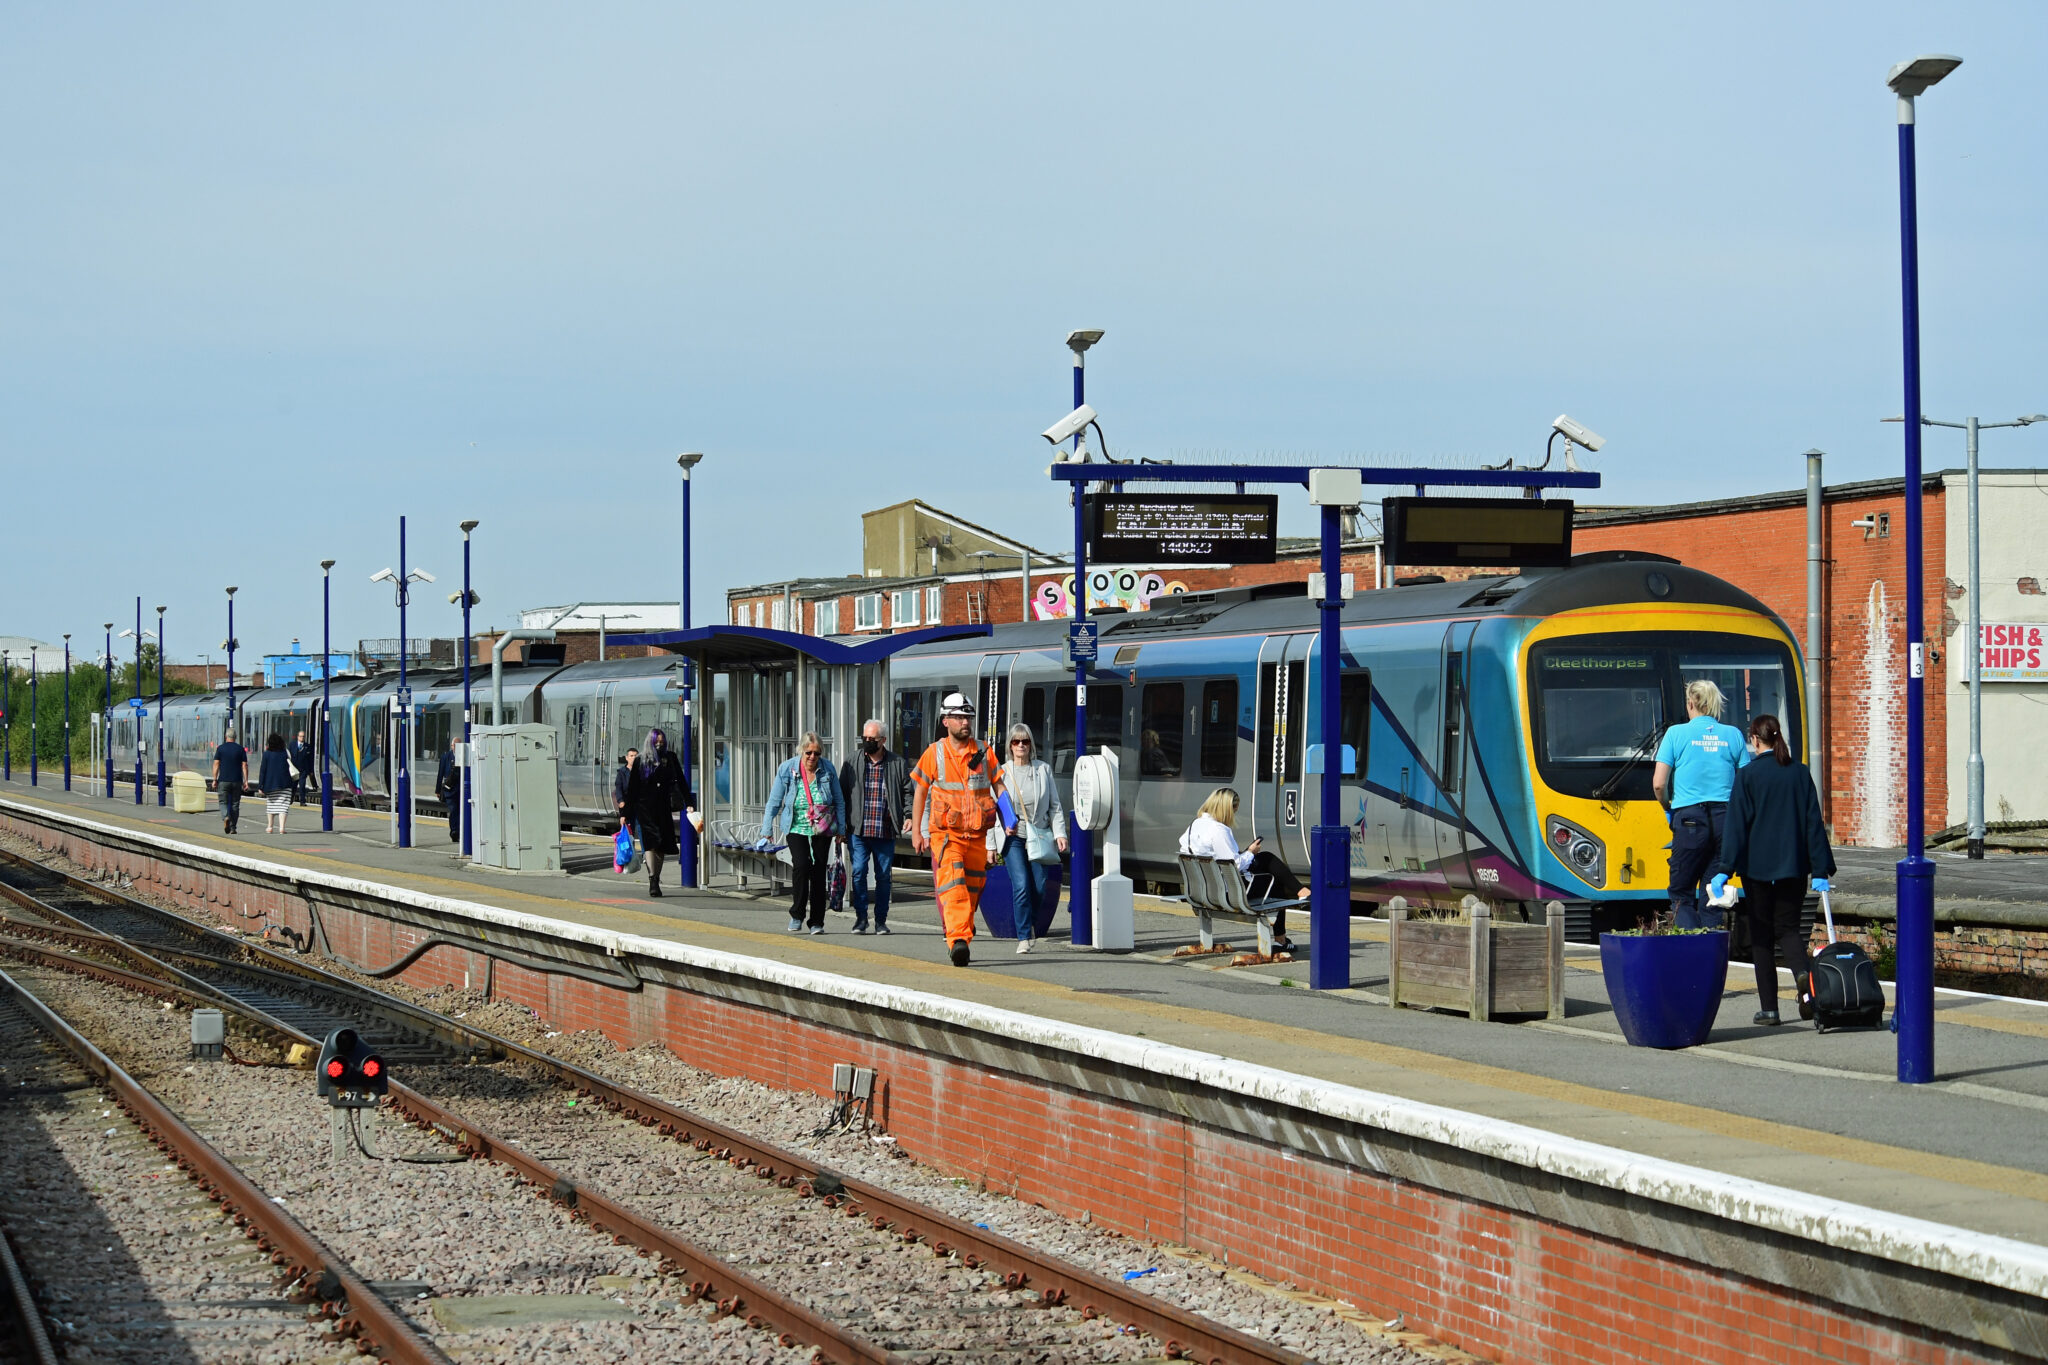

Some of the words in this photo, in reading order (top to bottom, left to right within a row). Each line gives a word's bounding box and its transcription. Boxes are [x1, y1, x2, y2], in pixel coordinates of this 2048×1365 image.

[1116, 513, 1141, 521] Calling
[2027, 628, 2044, 646] &
[1545, 657, 1647, 669] Cleethorpes
[337, 1091, 357, 1101] P97
